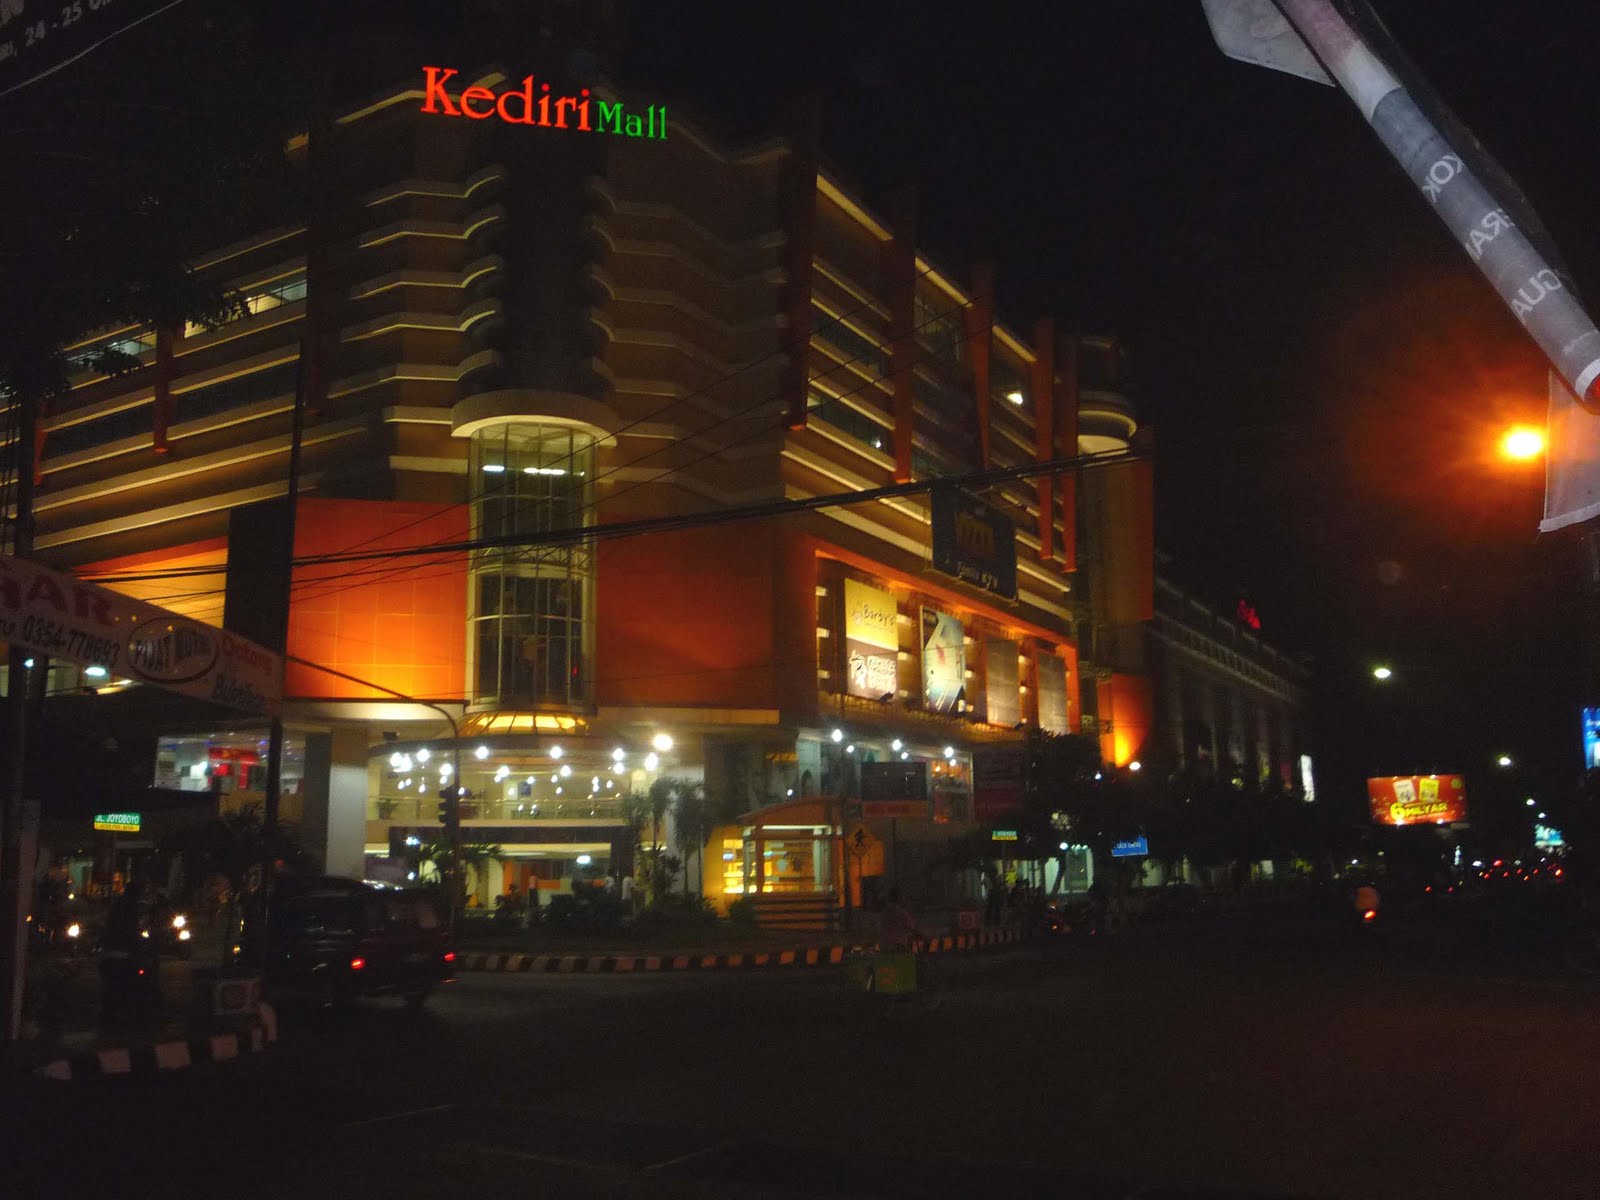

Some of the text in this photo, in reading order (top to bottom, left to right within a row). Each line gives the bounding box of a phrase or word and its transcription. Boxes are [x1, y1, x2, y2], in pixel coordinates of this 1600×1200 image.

[61, 0, 82, 28] 25
[420, 64, 669, 141] Kediri Mall
